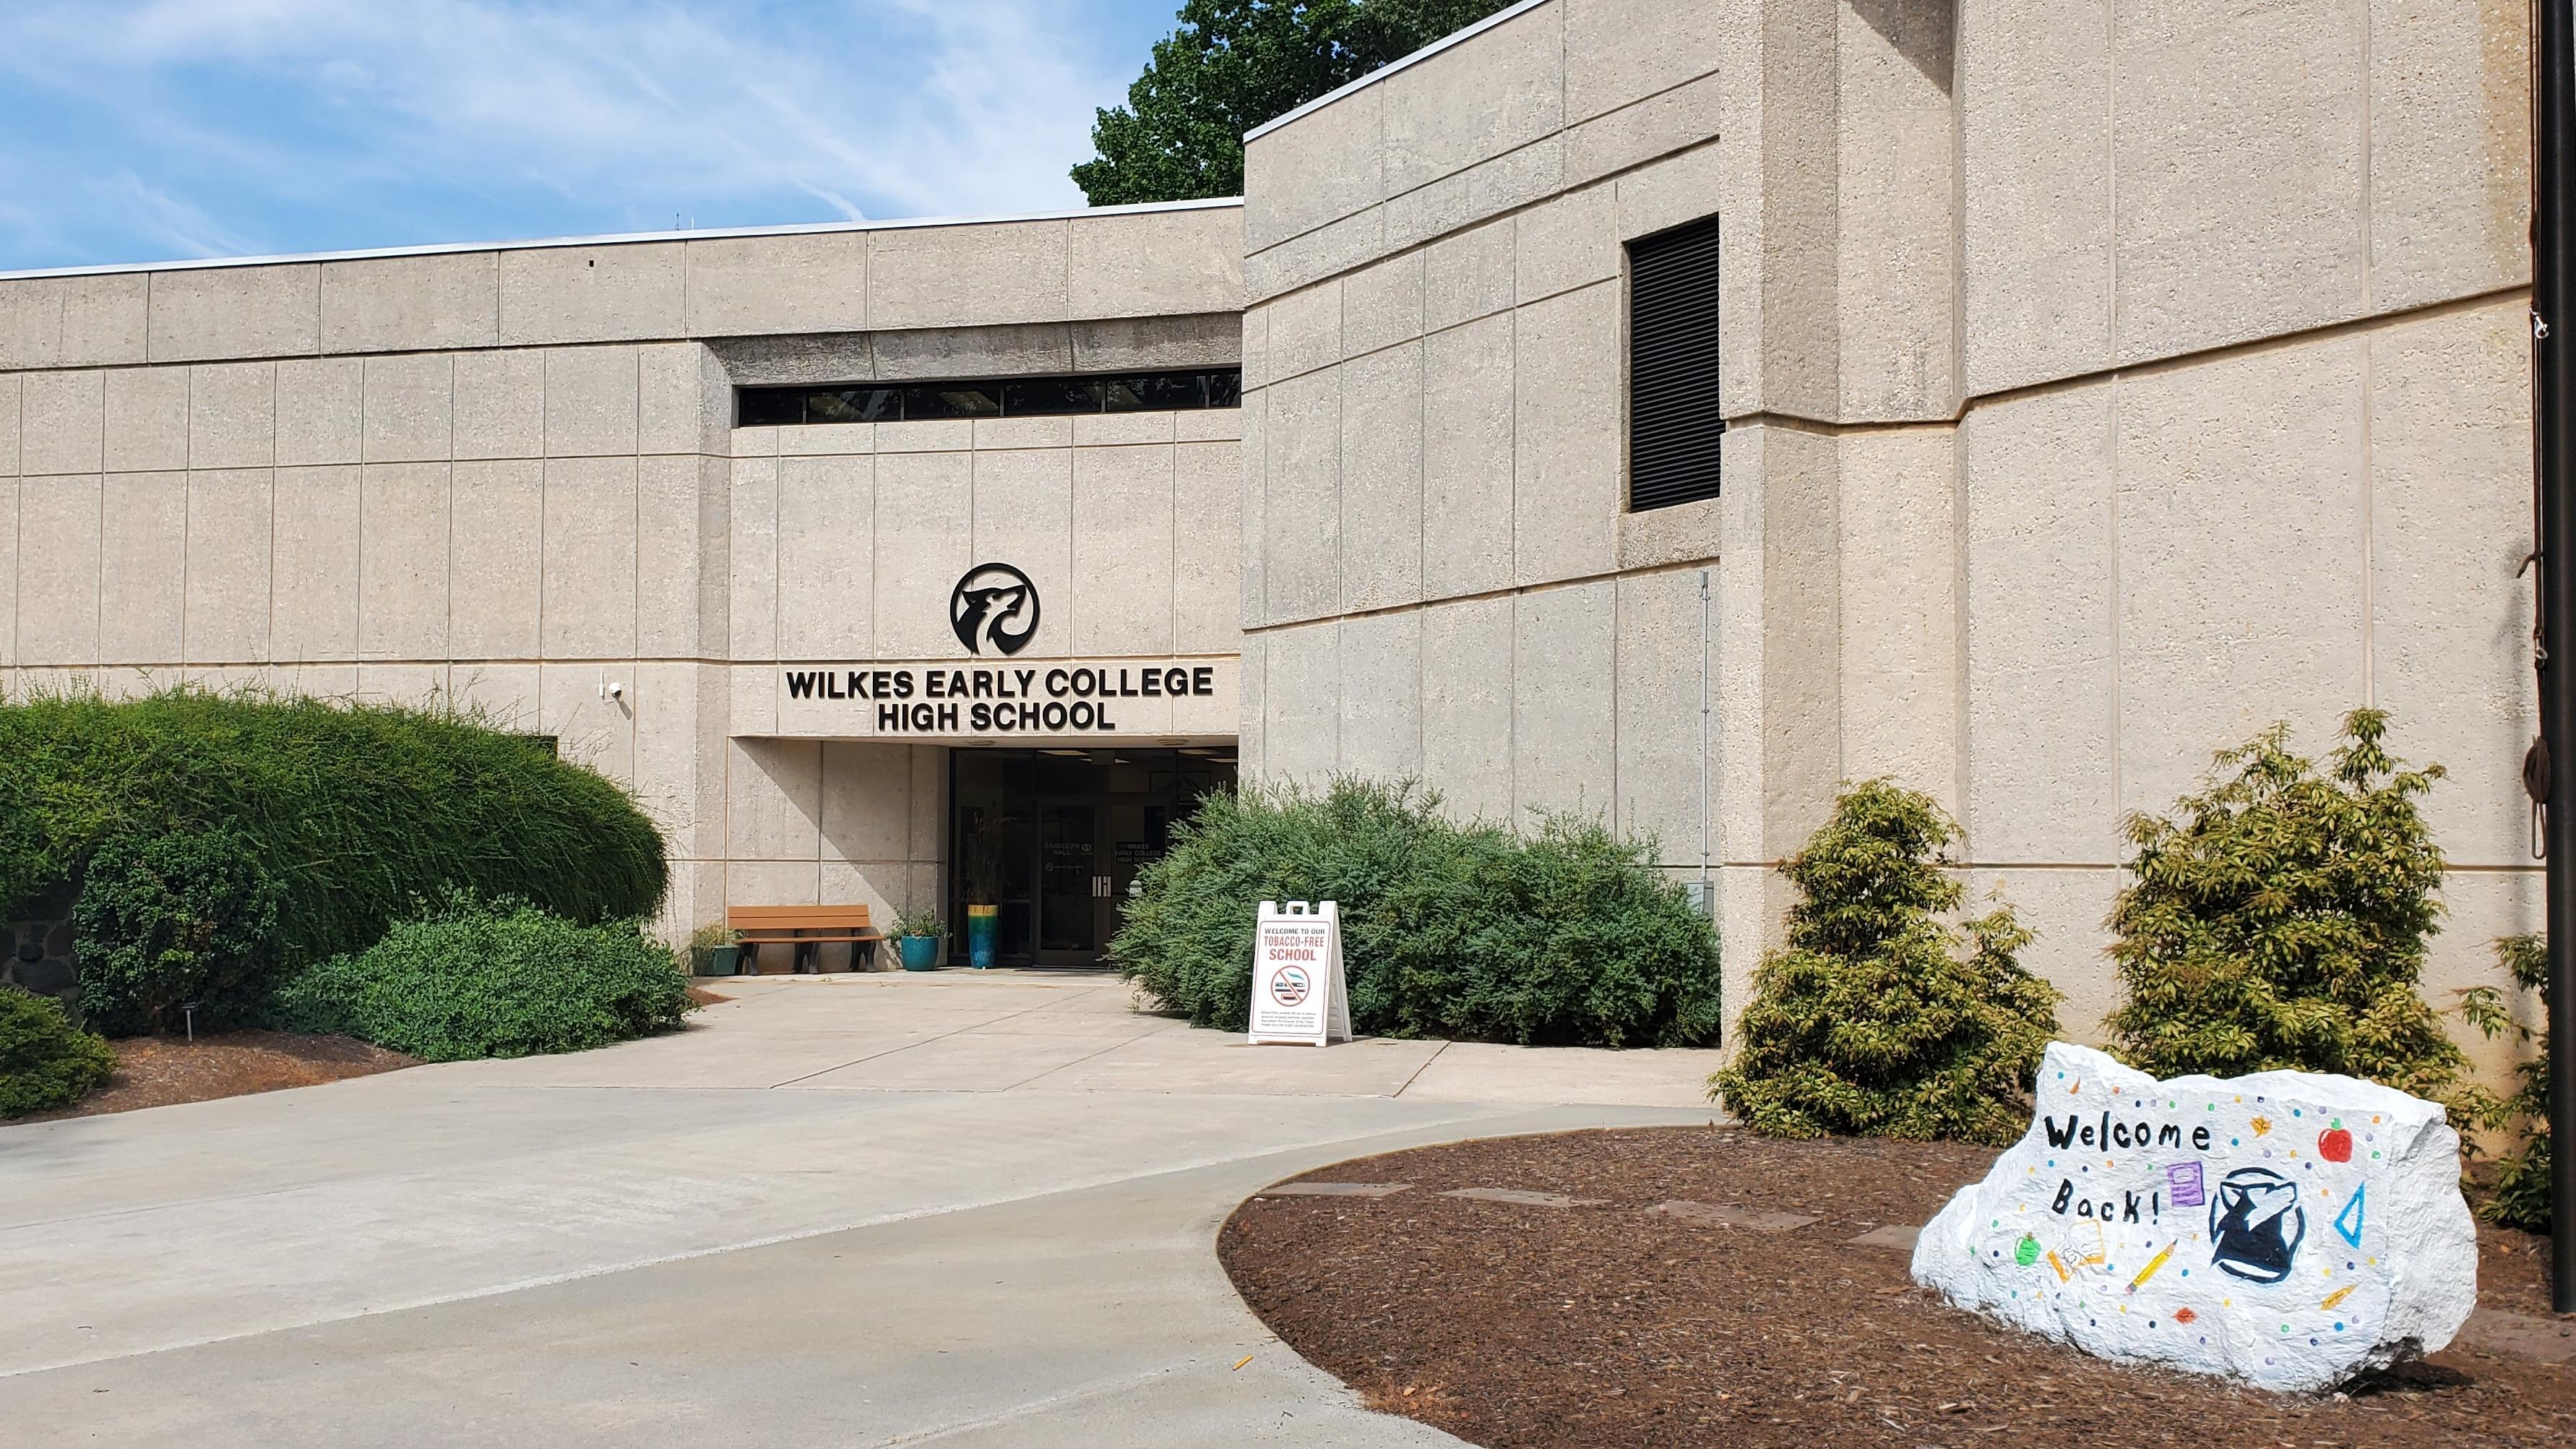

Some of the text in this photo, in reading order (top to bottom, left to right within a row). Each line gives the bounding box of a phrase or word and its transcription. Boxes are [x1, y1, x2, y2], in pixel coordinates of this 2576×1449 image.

[786, 667, 1213, 699] WILKES EARLY COLLEGE
[878, 701, 1116, 731] HIGH SCHOOL
[1264, 936, 1324, 947] TOBACCO-FREE
[1269, 949, 1317, 961] SCHOOL
[2044, 1111, 2210, 1152] Welcome
[2051, 1178, 2159, 1225] Back!
